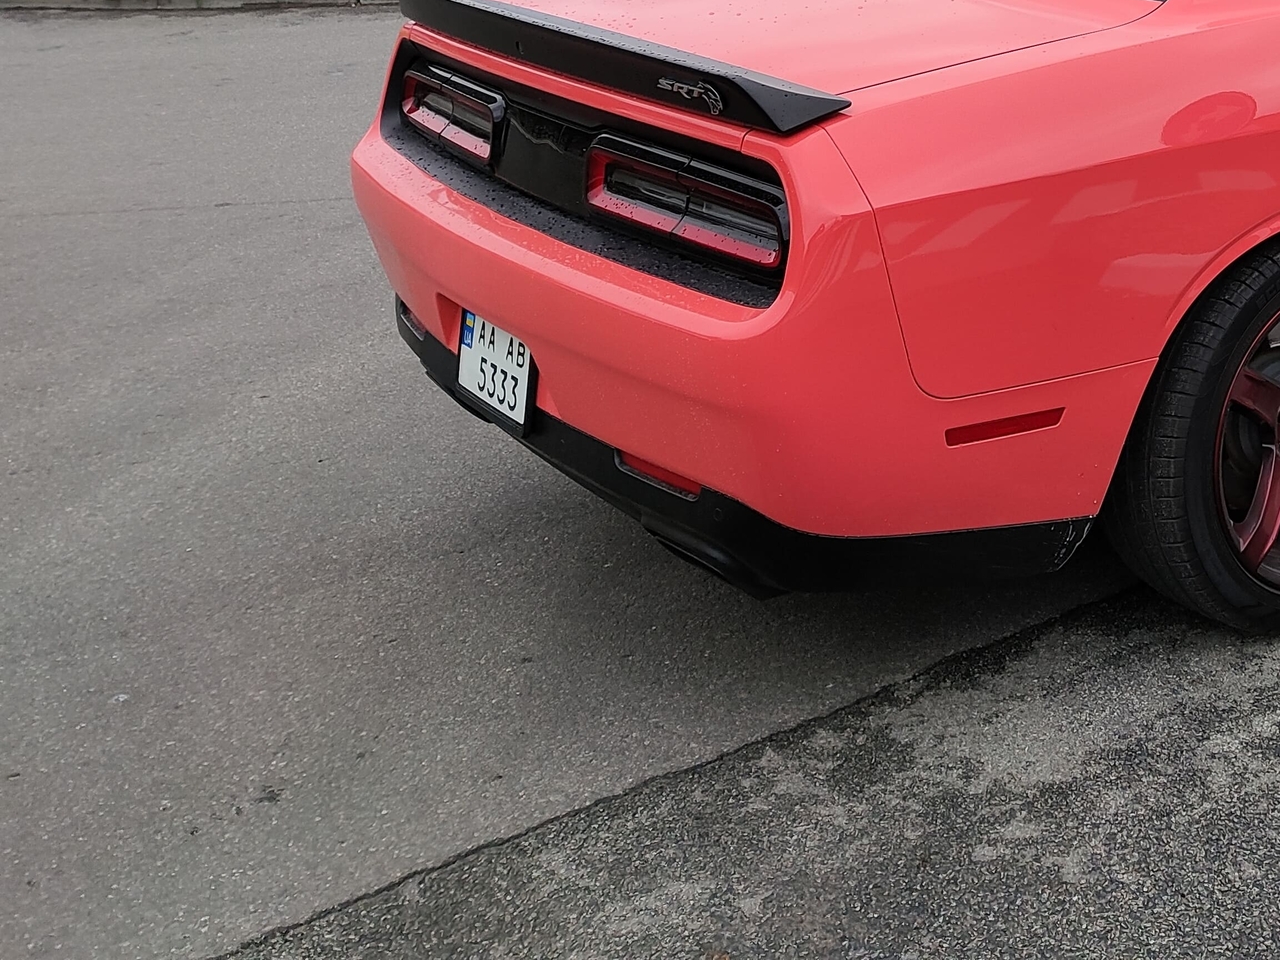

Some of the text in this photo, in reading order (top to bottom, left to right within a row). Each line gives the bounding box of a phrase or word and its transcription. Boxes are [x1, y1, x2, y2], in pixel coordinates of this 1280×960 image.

[656, 77, 705, 100] SRT
[478, 320, 526, 369] AA AB
[478, 356, 519, 412] 5333
